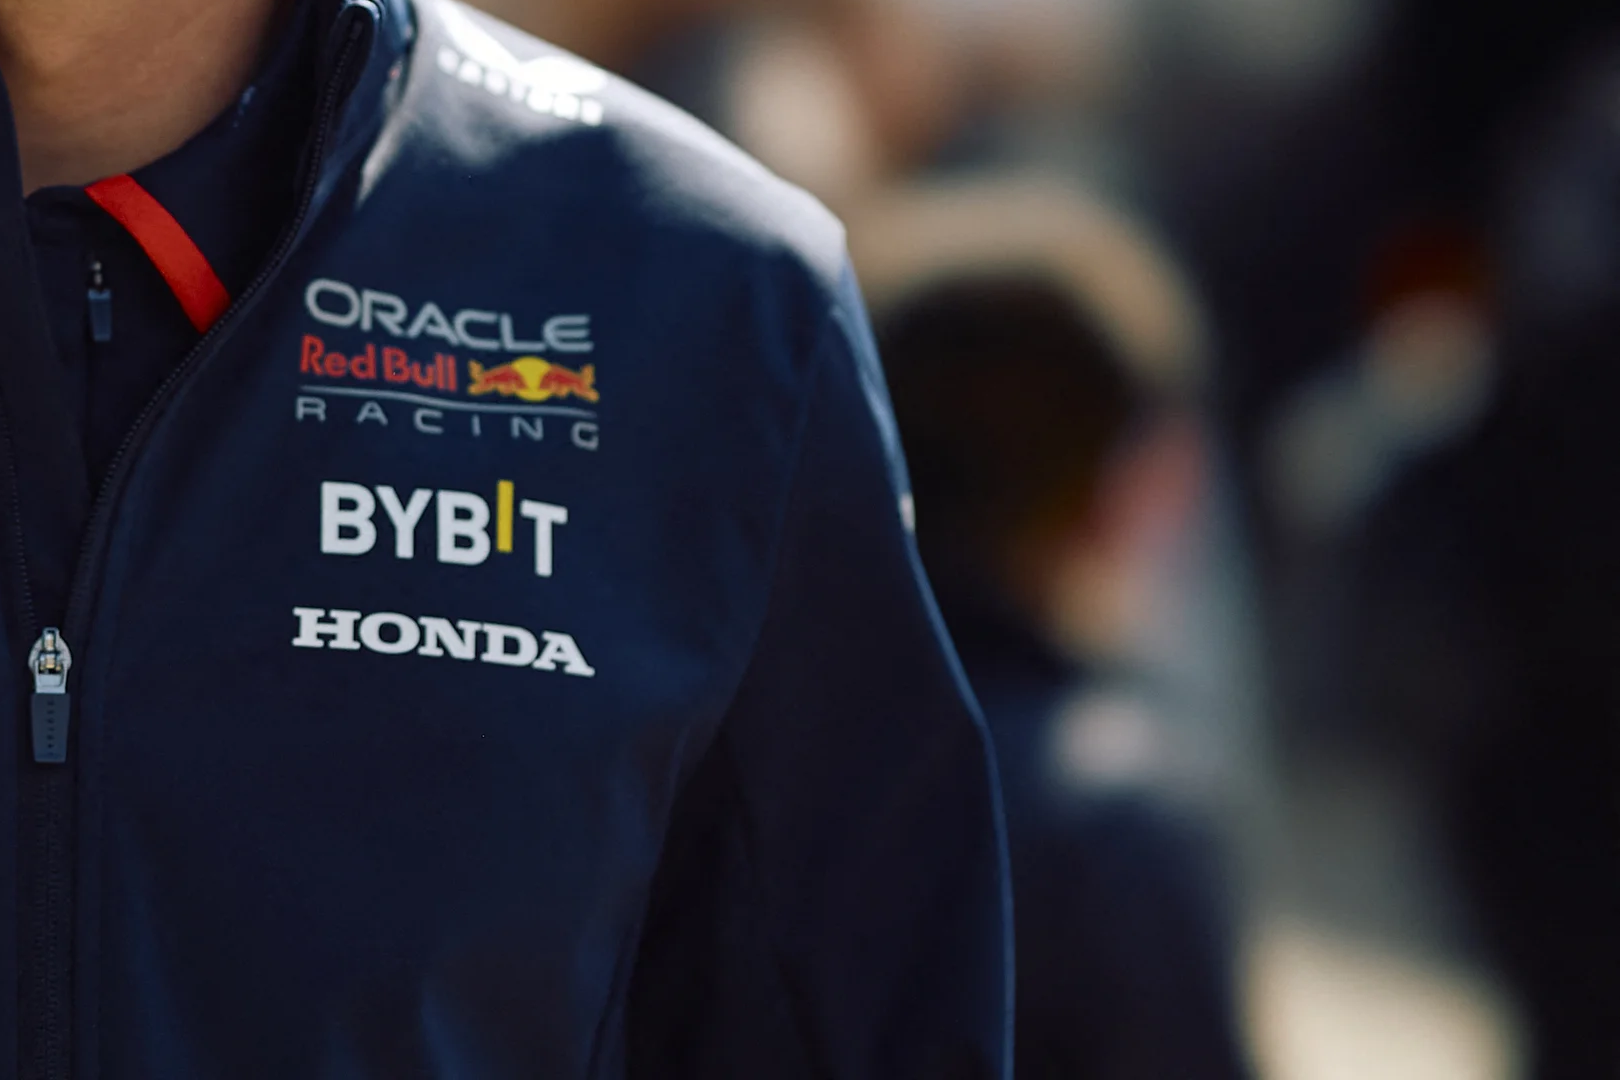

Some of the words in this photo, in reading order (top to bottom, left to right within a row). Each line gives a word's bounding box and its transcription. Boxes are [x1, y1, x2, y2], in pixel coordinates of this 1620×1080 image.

[303, 276, 596, 353] ORACLE
[299, 333, 377, 380] Red
[381, 345, 458, 393] Bull
[294, 395, 600, 452] RACING
[319, 478, 570, 578] BYBIT
[290, 605, 597, 678] HONDA
